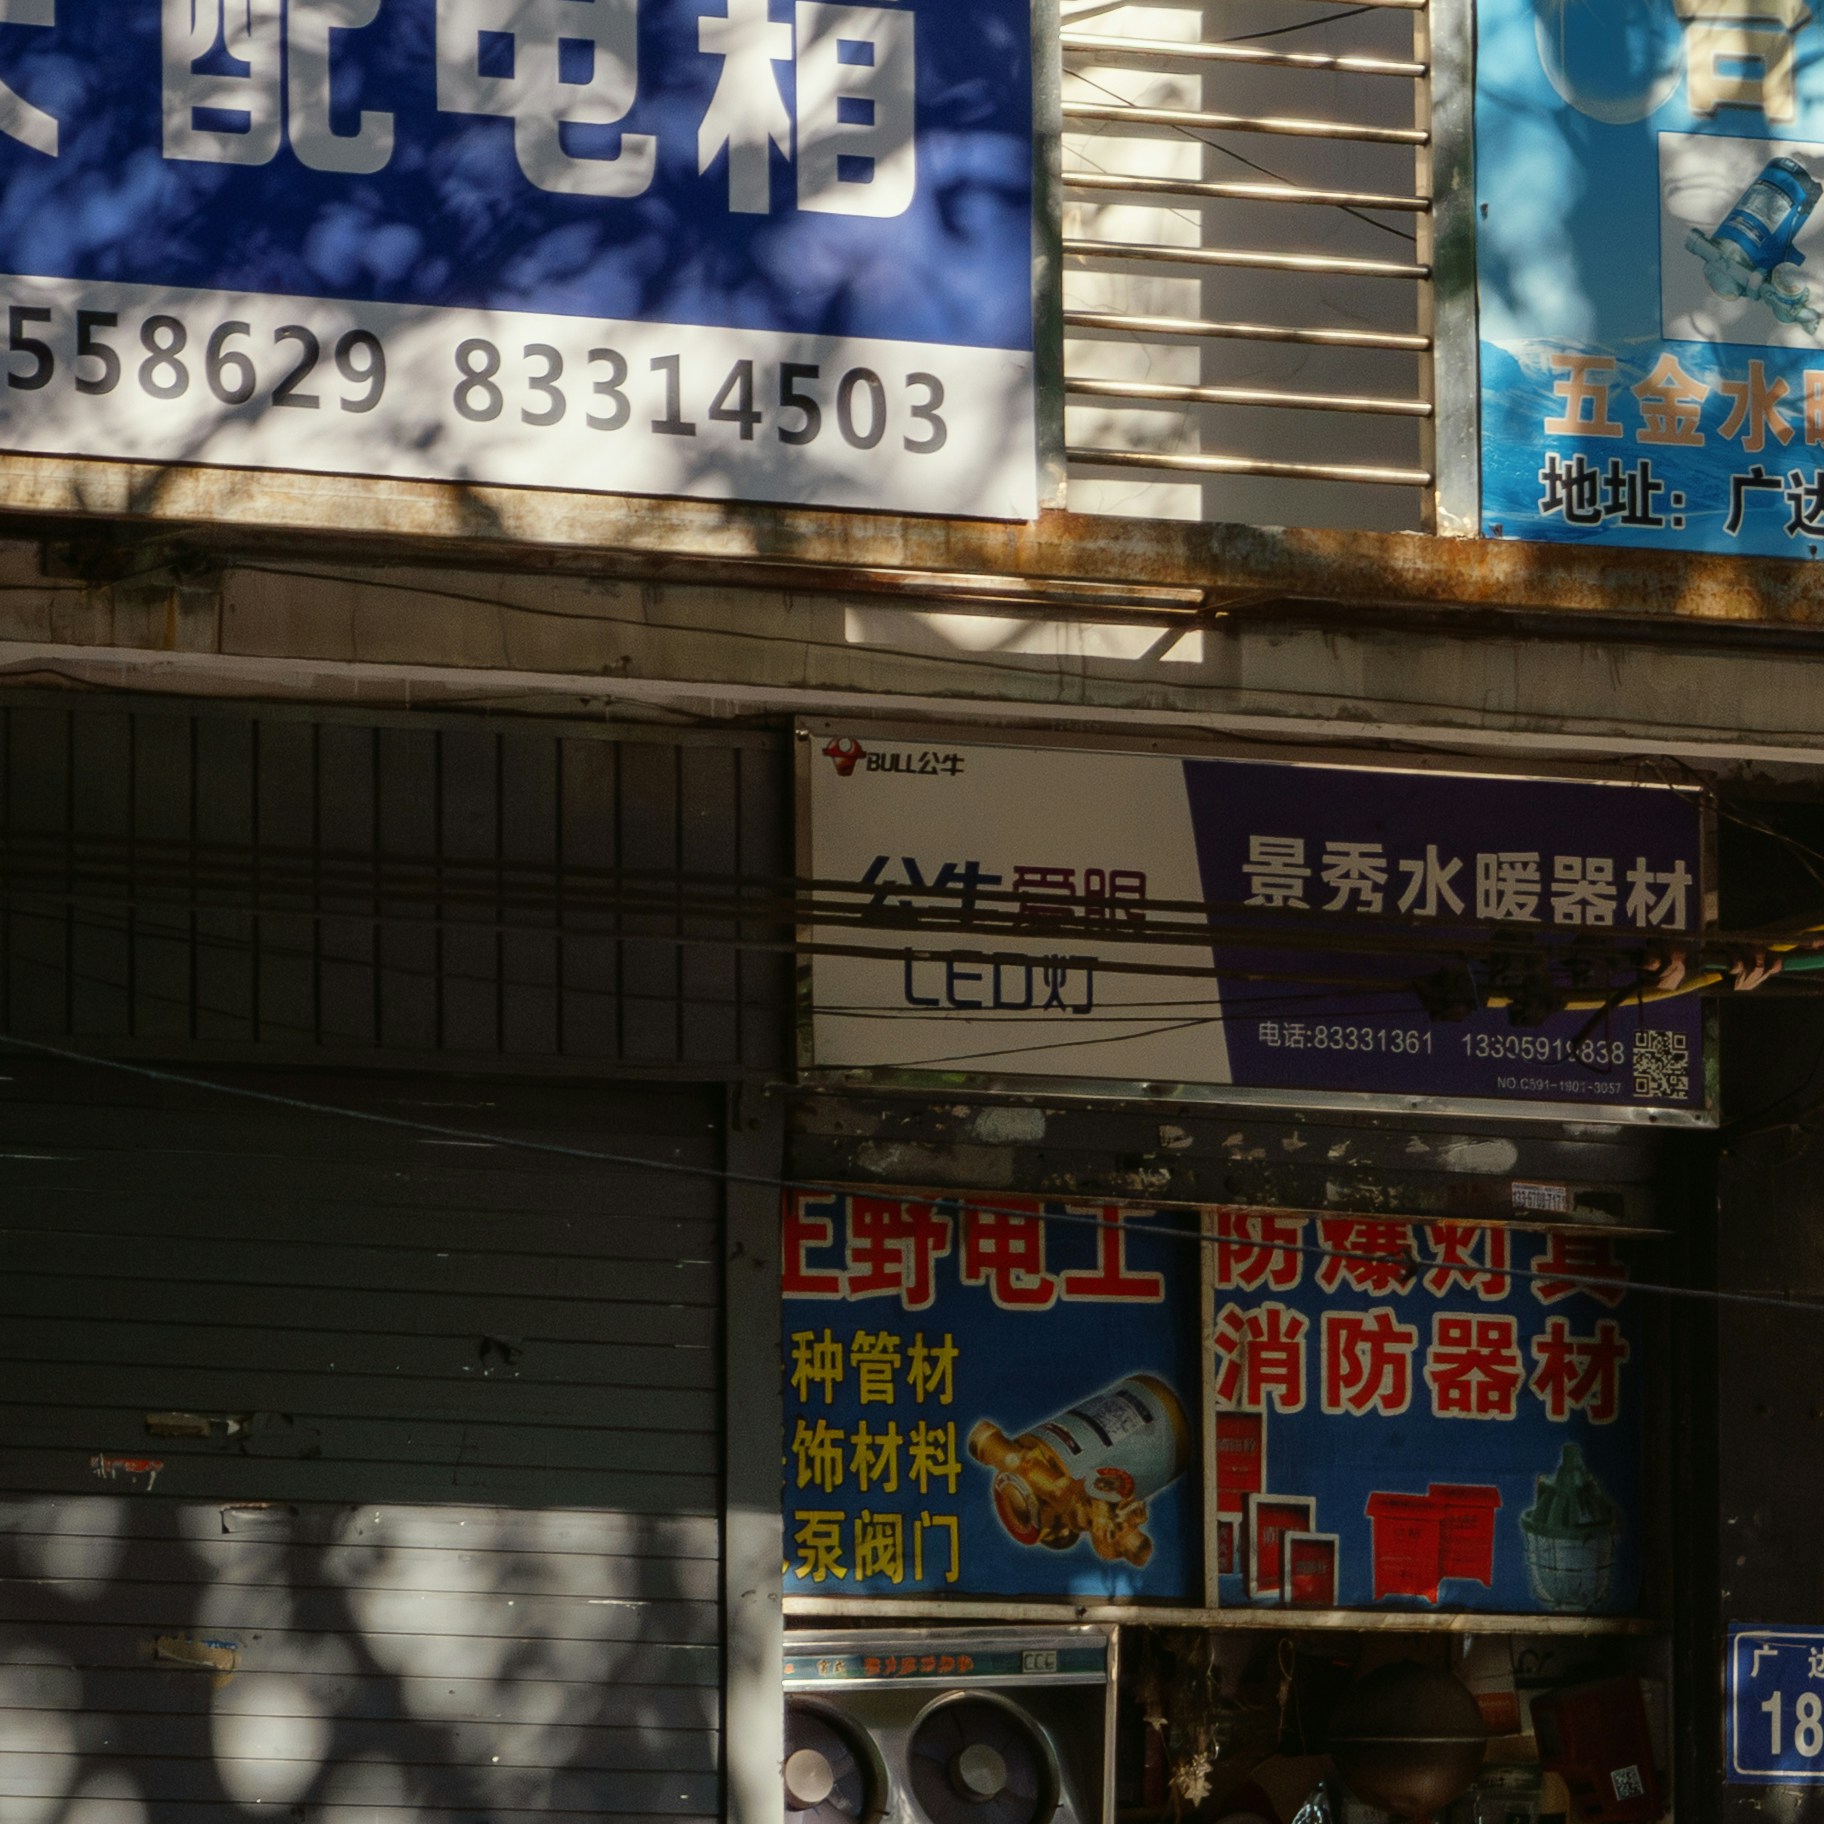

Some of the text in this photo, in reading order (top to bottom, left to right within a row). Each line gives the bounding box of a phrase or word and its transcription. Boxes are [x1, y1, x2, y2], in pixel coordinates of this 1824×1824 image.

[6, 305, 949, 455] 558629 83314503
[1242, 834, 1693, 931] 景秀水暖器材
[903, 947, 1099, 1015] LED灯
[1214, 1302, 1630, 1425] 消防器材
[784, 1416, 964, 1495] 饰材料
[783, 1508, 961, 1586] 泵阀门
